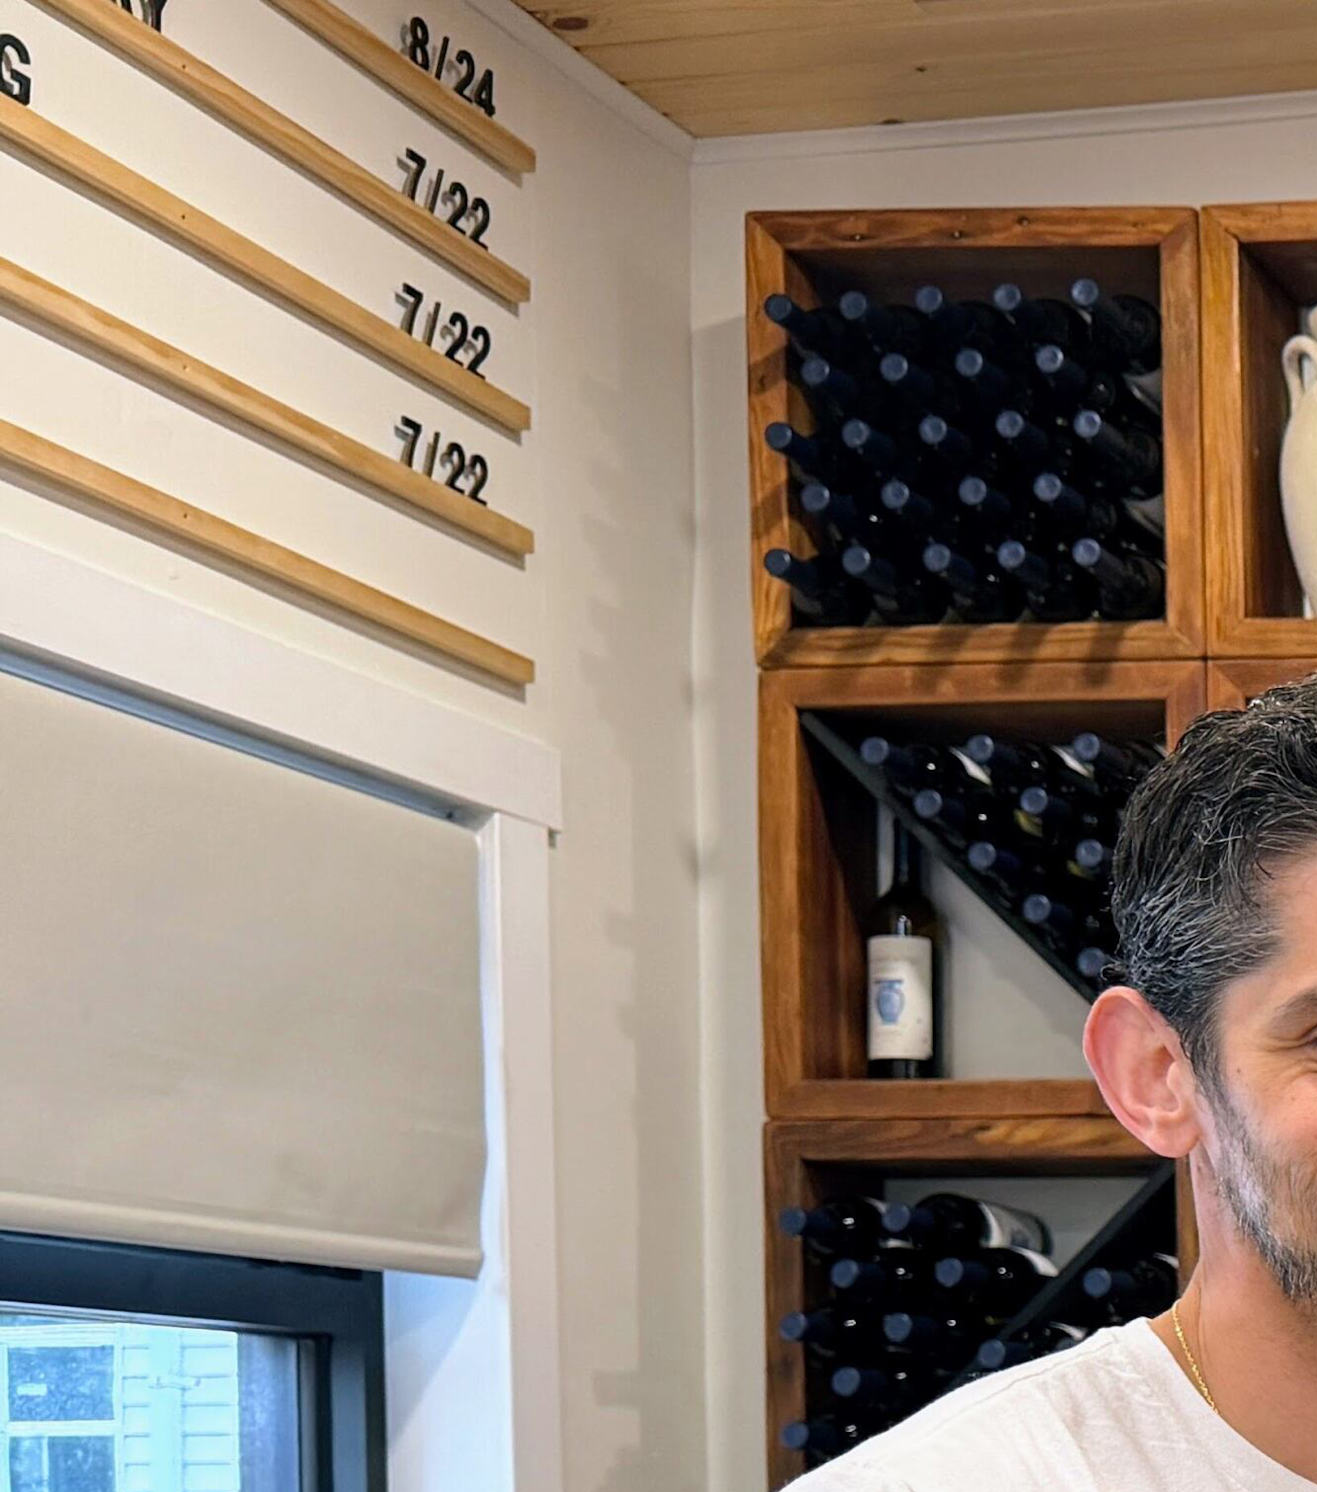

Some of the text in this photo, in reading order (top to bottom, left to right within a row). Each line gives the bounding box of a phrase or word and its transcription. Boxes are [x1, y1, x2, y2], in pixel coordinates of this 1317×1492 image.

[408, 16, 496, 117] 8/24
[404, 147, 490, 252] 7/22
[402, 282, 491, 380] 7/22
[400, 415, 489, 506] 7/22
